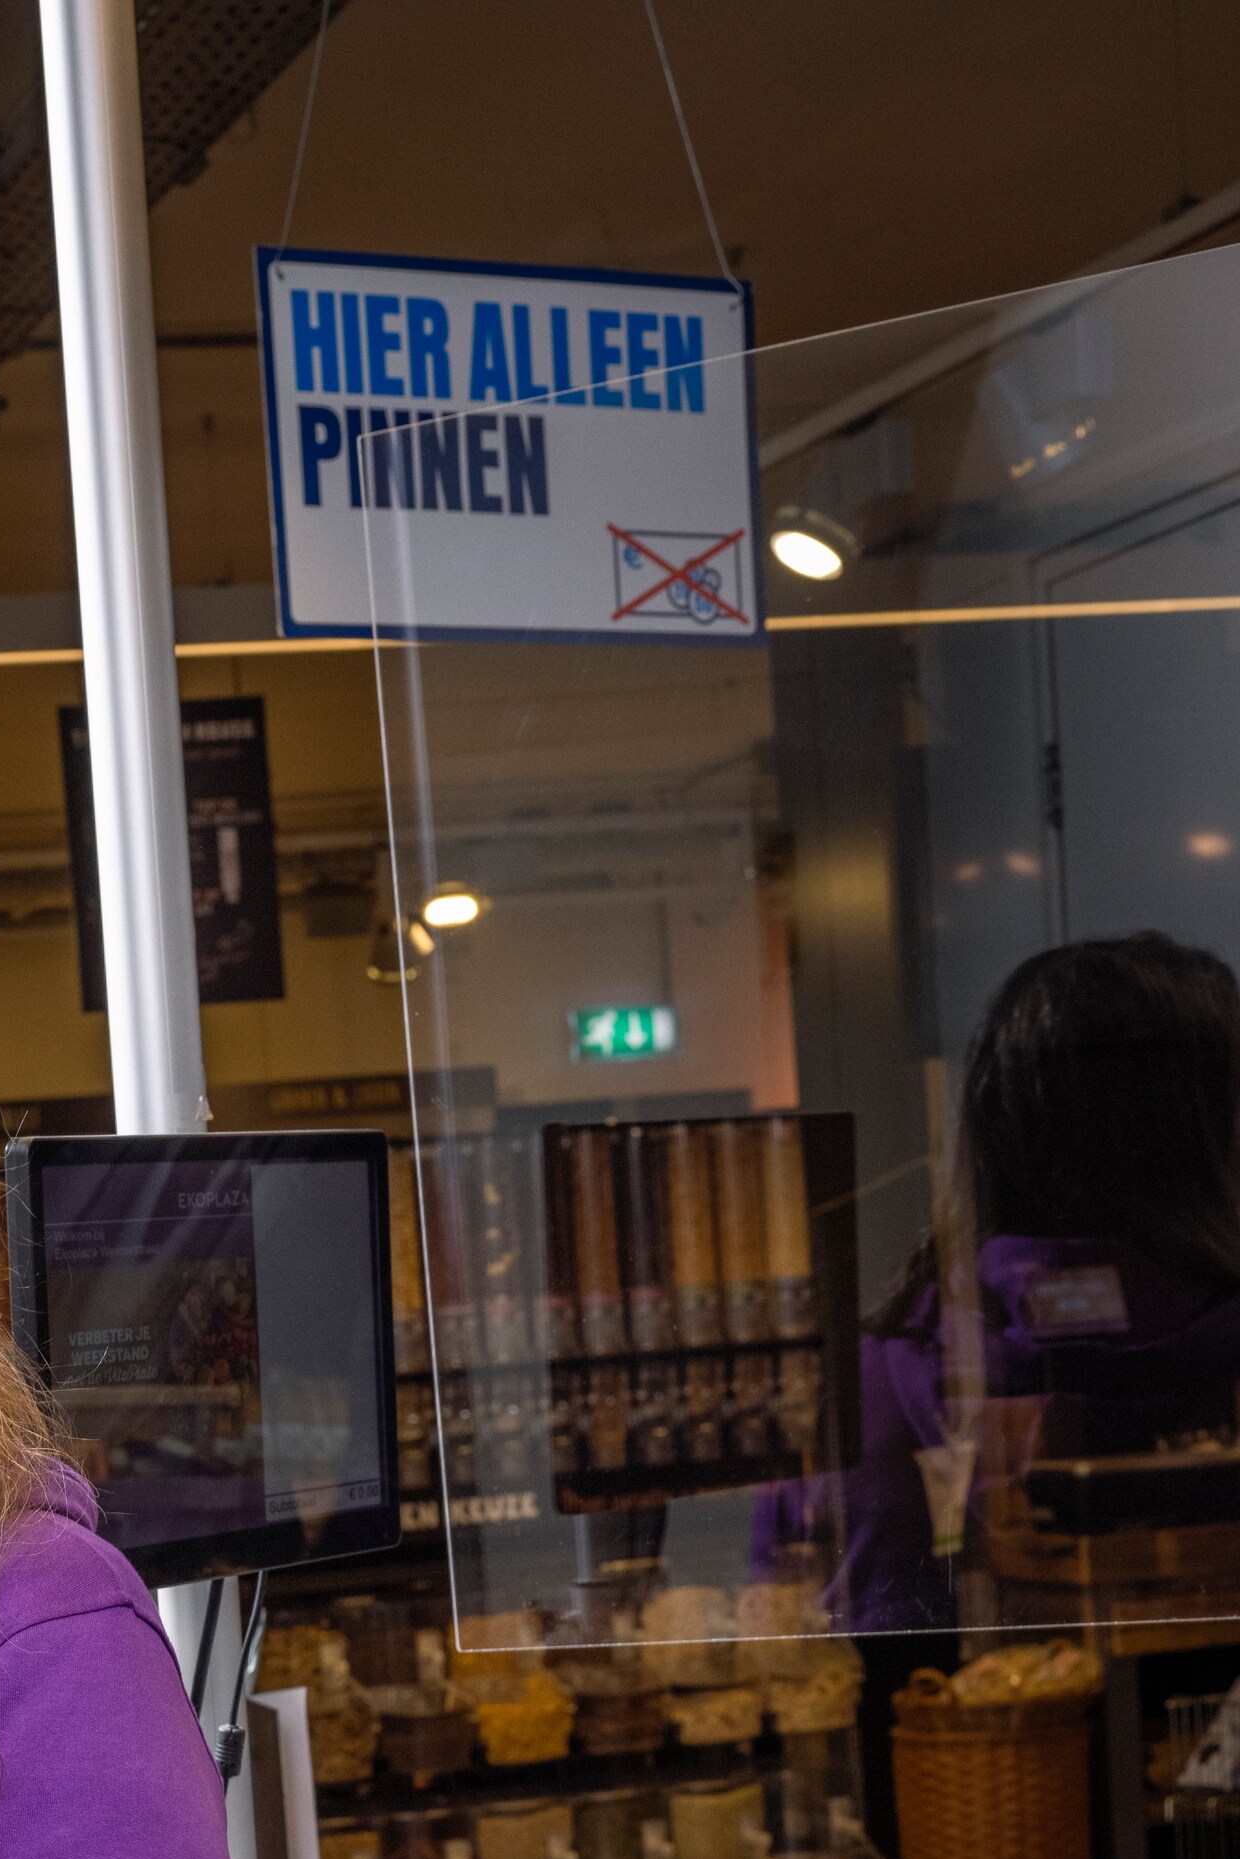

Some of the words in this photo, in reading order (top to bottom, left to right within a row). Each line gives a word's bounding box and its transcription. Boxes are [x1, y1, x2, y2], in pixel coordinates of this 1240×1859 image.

[291, 289, 452, 399] HIER
[469, 301, 706, 414] ALLEEN
[297, 404, 549, 516] PINNEN
[177, 1190, 249, 1209] EKOPLAZA
[68, 1327, 133, 1347] VERBETER
[135, 1325, 152, 1342] JE
